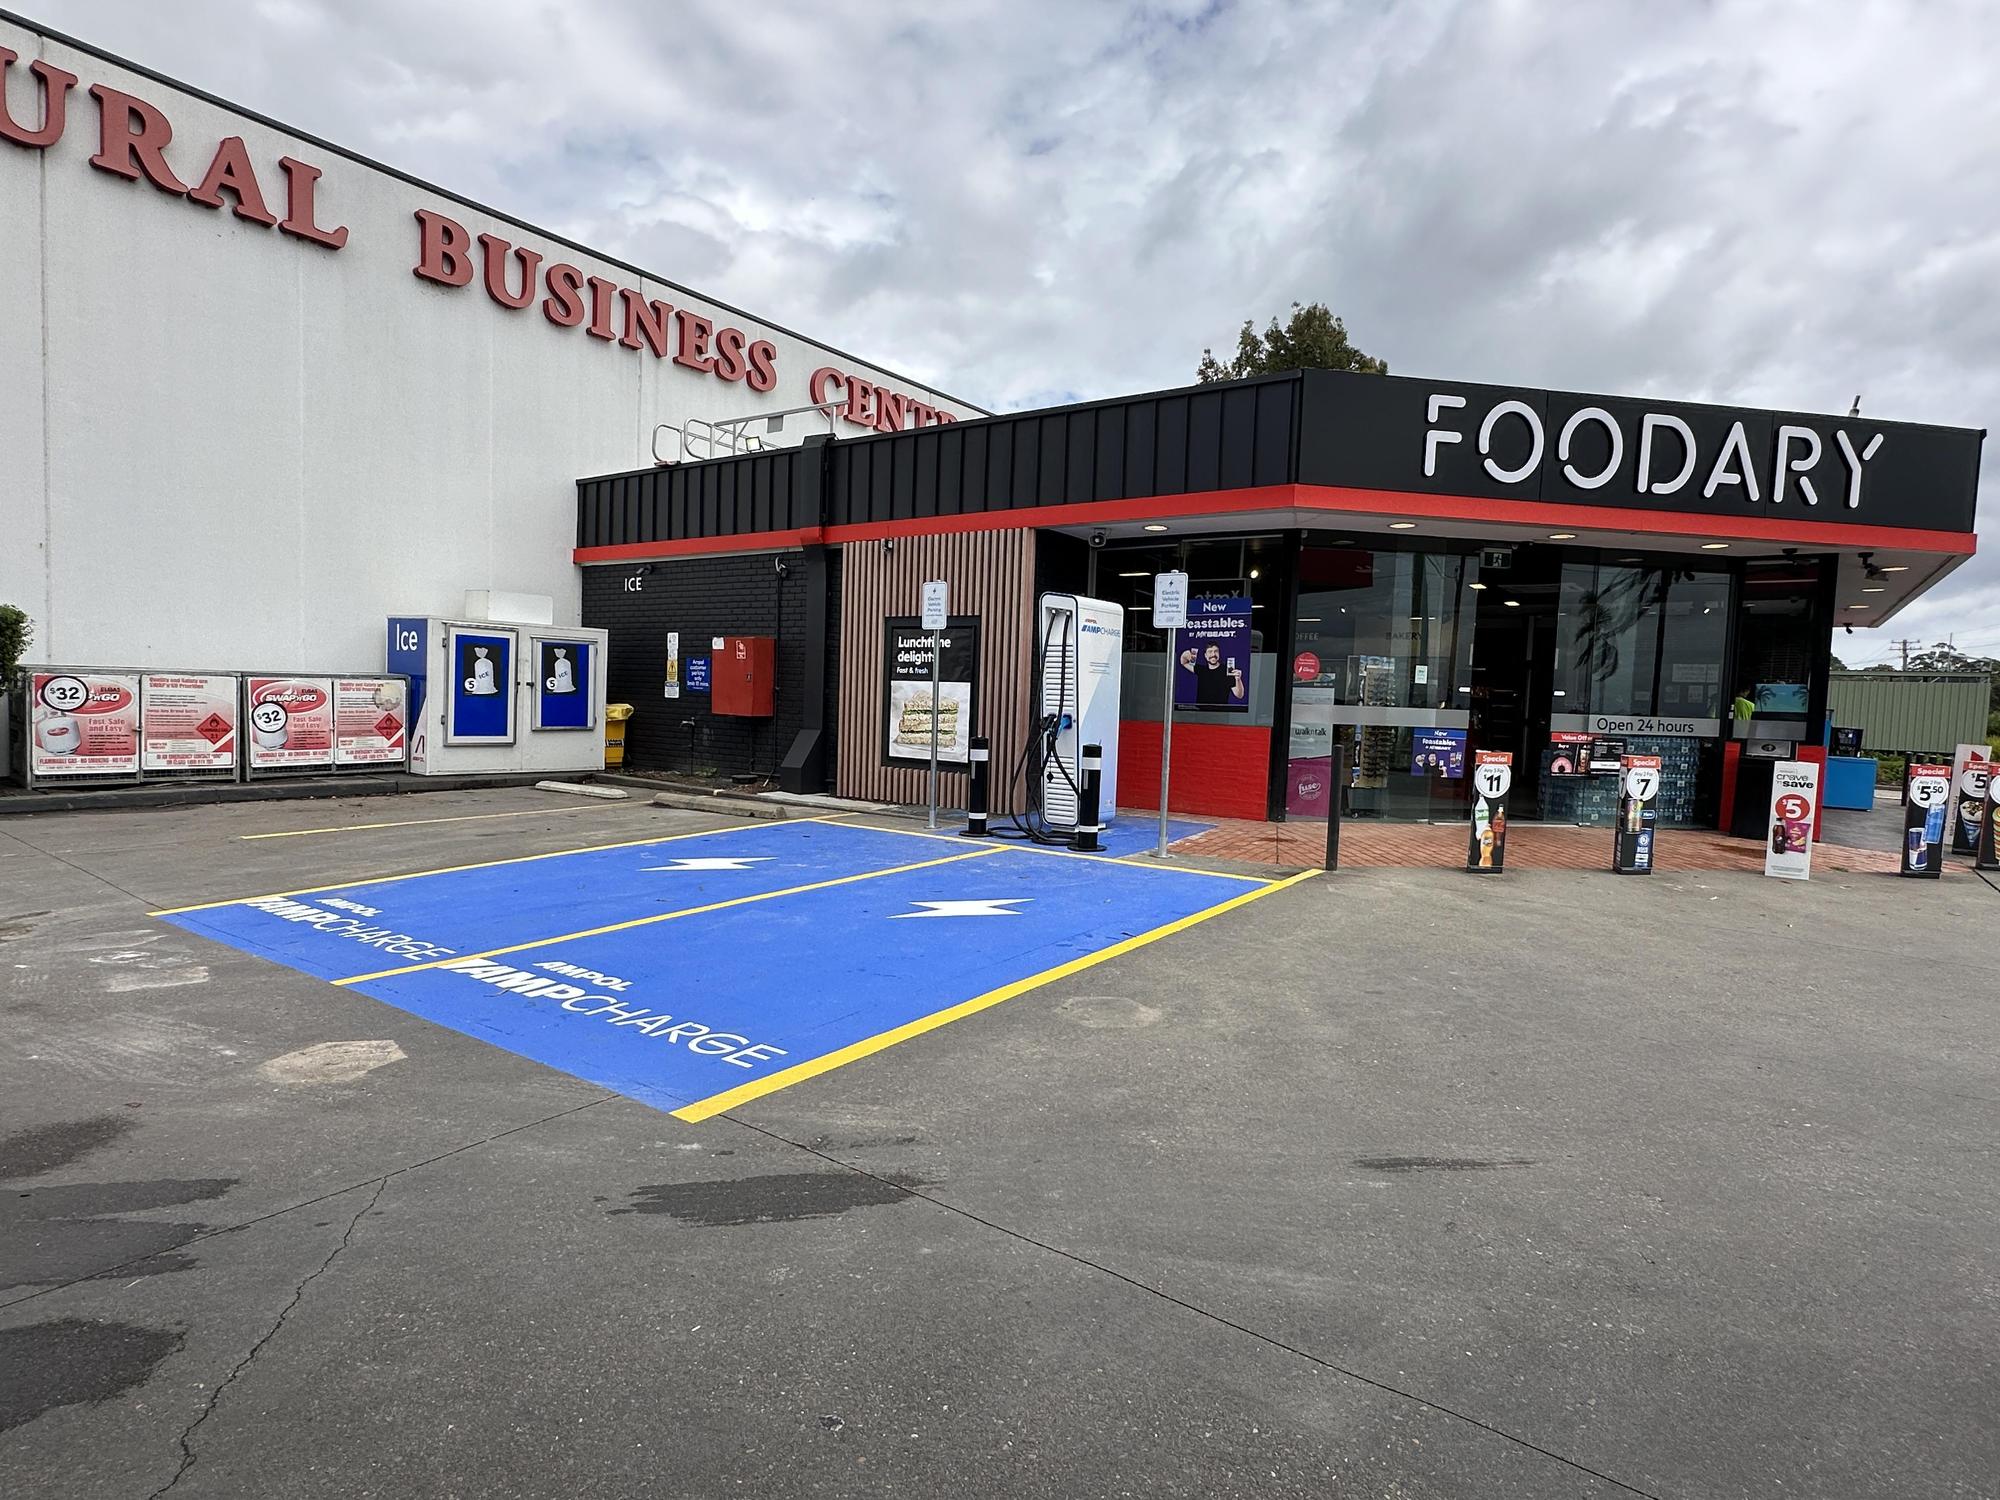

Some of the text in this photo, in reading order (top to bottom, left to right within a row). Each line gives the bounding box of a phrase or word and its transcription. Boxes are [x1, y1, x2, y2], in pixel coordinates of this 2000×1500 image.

[0, 46, 349, 250] URAL
[413, 209, 777, 393] BUSINESS
[1424, 393, 1884, 508] FOODARY
[624, 577, 643, 592] ICE
[1203, 602, 1226, 612] New
[396, 624, 418, 651] Ice
[479, 671, 489, 680] ICE
[49, 687, 80, 700] $32
[257, 710, 281, 724] $32
[105, 725, 122, 733] Easy
[1597, 718, 1694, 733] Open 24 hours
[1482, 755, 1508, 763] Special
[1633, 759, 1656, 767] Special
[1776, 773, 1809, 781] crave
[1917, 768, 1945, 776] Special
[1484, 774, 1501, 792] $11
[1637, 778, 1651, 796] $7
[1782, 781, 1814, 789] save
[1917, 785, 1944, 801] $5.50
[1782, 799, 1801, 819] $5
[248, 896, 457, 961] AMPCHARGE
[533, 961, 637, 992] AMPOL
[438, 958, 789, 1068] AMPCHARGE
